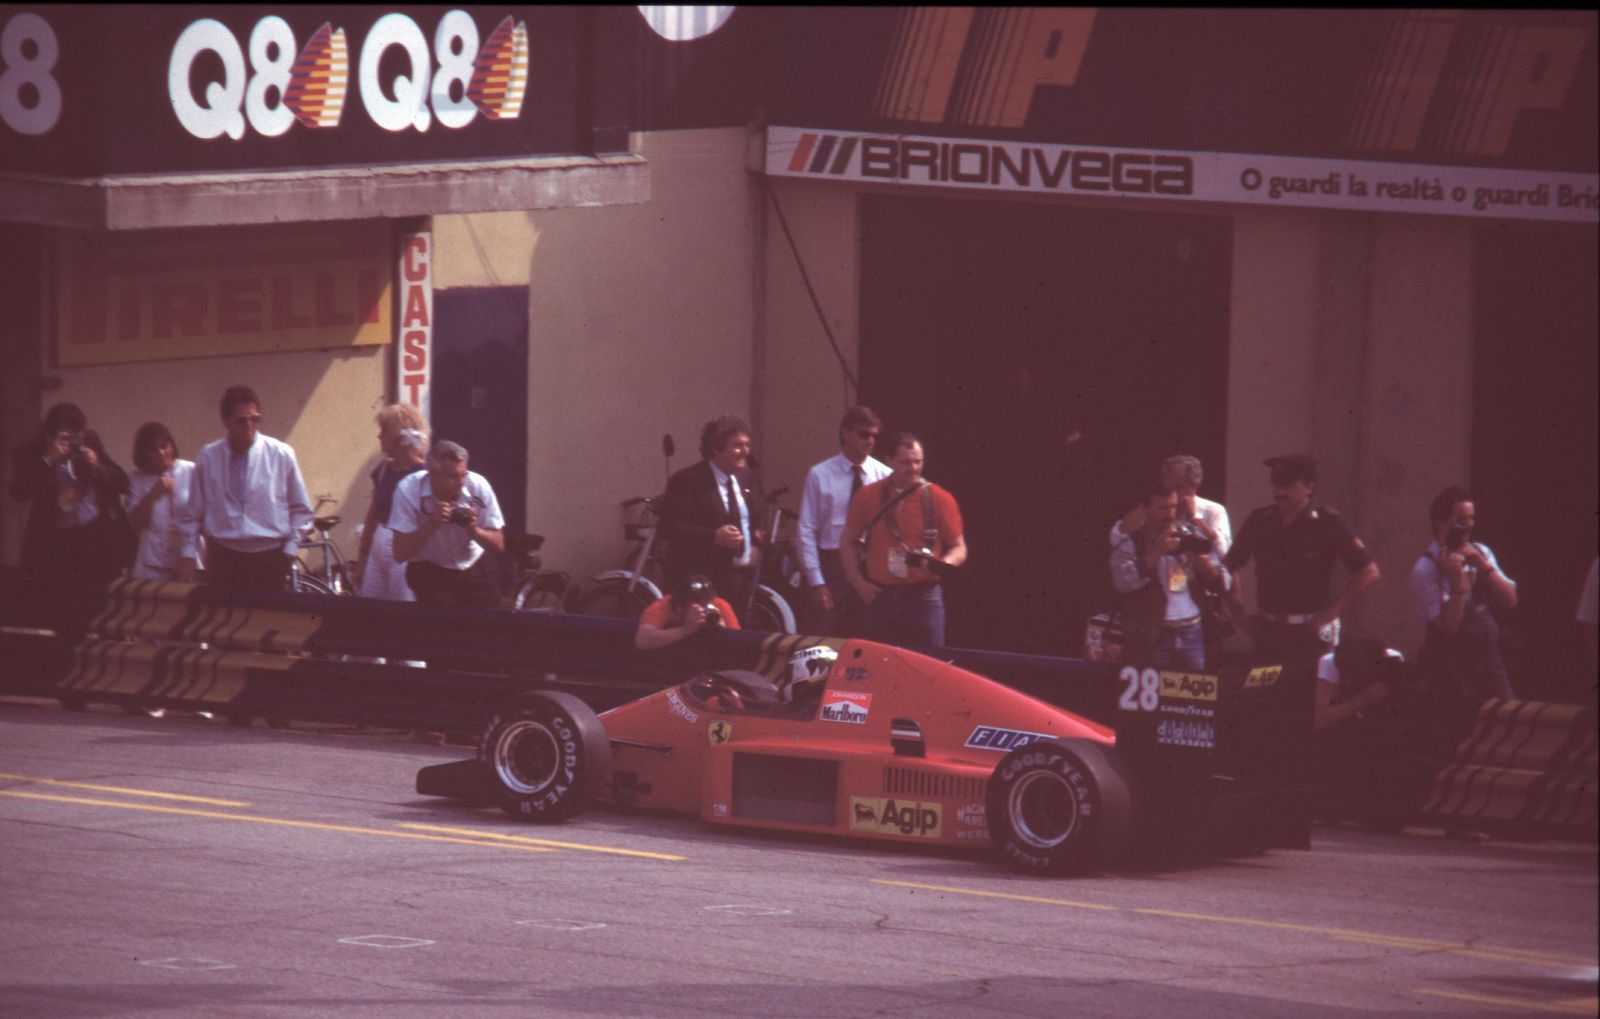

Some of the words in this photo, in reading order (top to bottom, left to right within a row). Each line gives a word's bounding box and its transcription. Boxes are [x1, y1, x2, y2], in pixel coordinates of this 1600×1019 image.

[168, 15, 299, 140] Q8
[358, 9, 481, 132] Q8
[1240, 167, 1263, 191] O
[1268, 172, 1341, 198] guardi
[1349, 174, 1369, 197] la
[1376, 176, 1444, 201] realtà
[1452, 187, 1467, 203] o
[1474, 183, 1549, 210] guardi
[1118, 665, 1160, 712] 28
[1180, 675, 1215, 697] Agip
[821, 703, 867, 722] Marlboro
[880, 799, 938, 837] Agip
